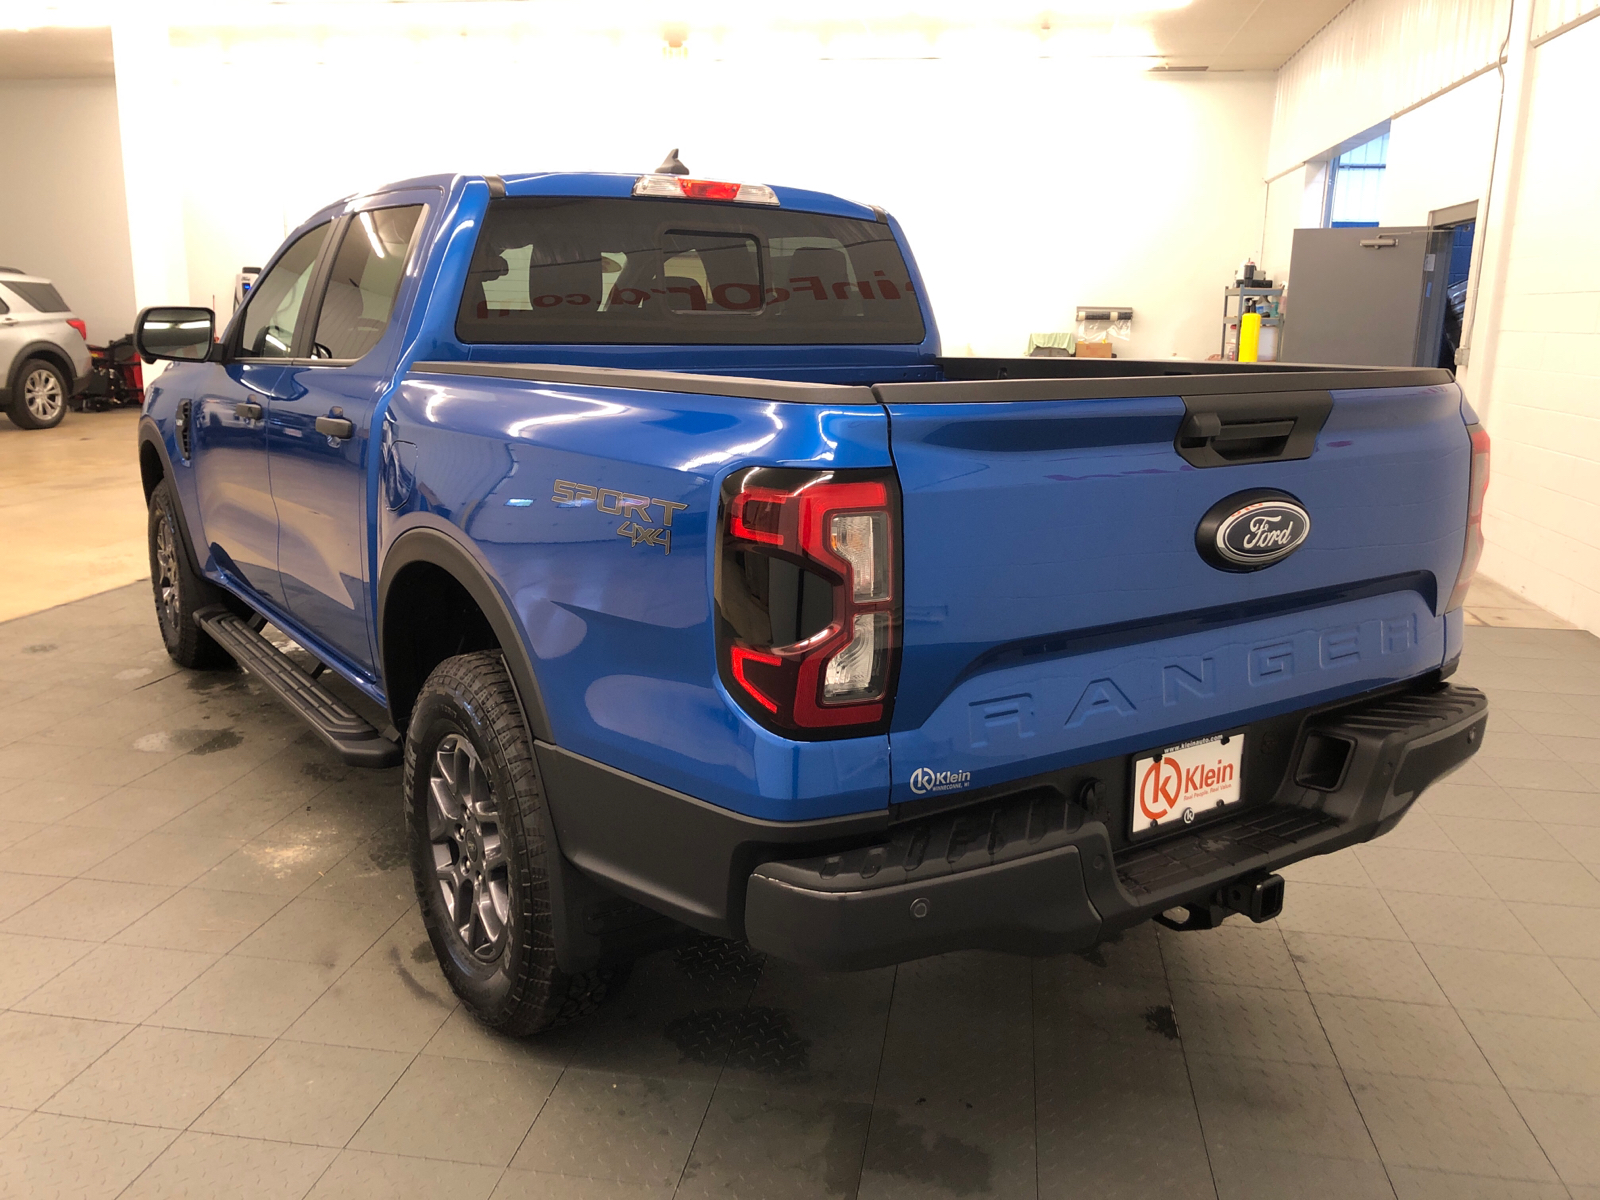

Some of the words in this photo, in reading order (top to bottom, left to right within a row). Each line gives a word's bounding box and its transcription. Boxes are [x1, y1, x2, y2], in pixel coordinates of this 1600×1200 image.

[551, 479, 689, 526] SPORT
[1243, 515, 1293, 549] Ford
[968, 612, 1418, 748] RANGER
[1164, 735, 1223, 754] www.kleinauto.com
[936, 770, 971, 785] Klein
[1184, 759, 1233, 794] Klein
